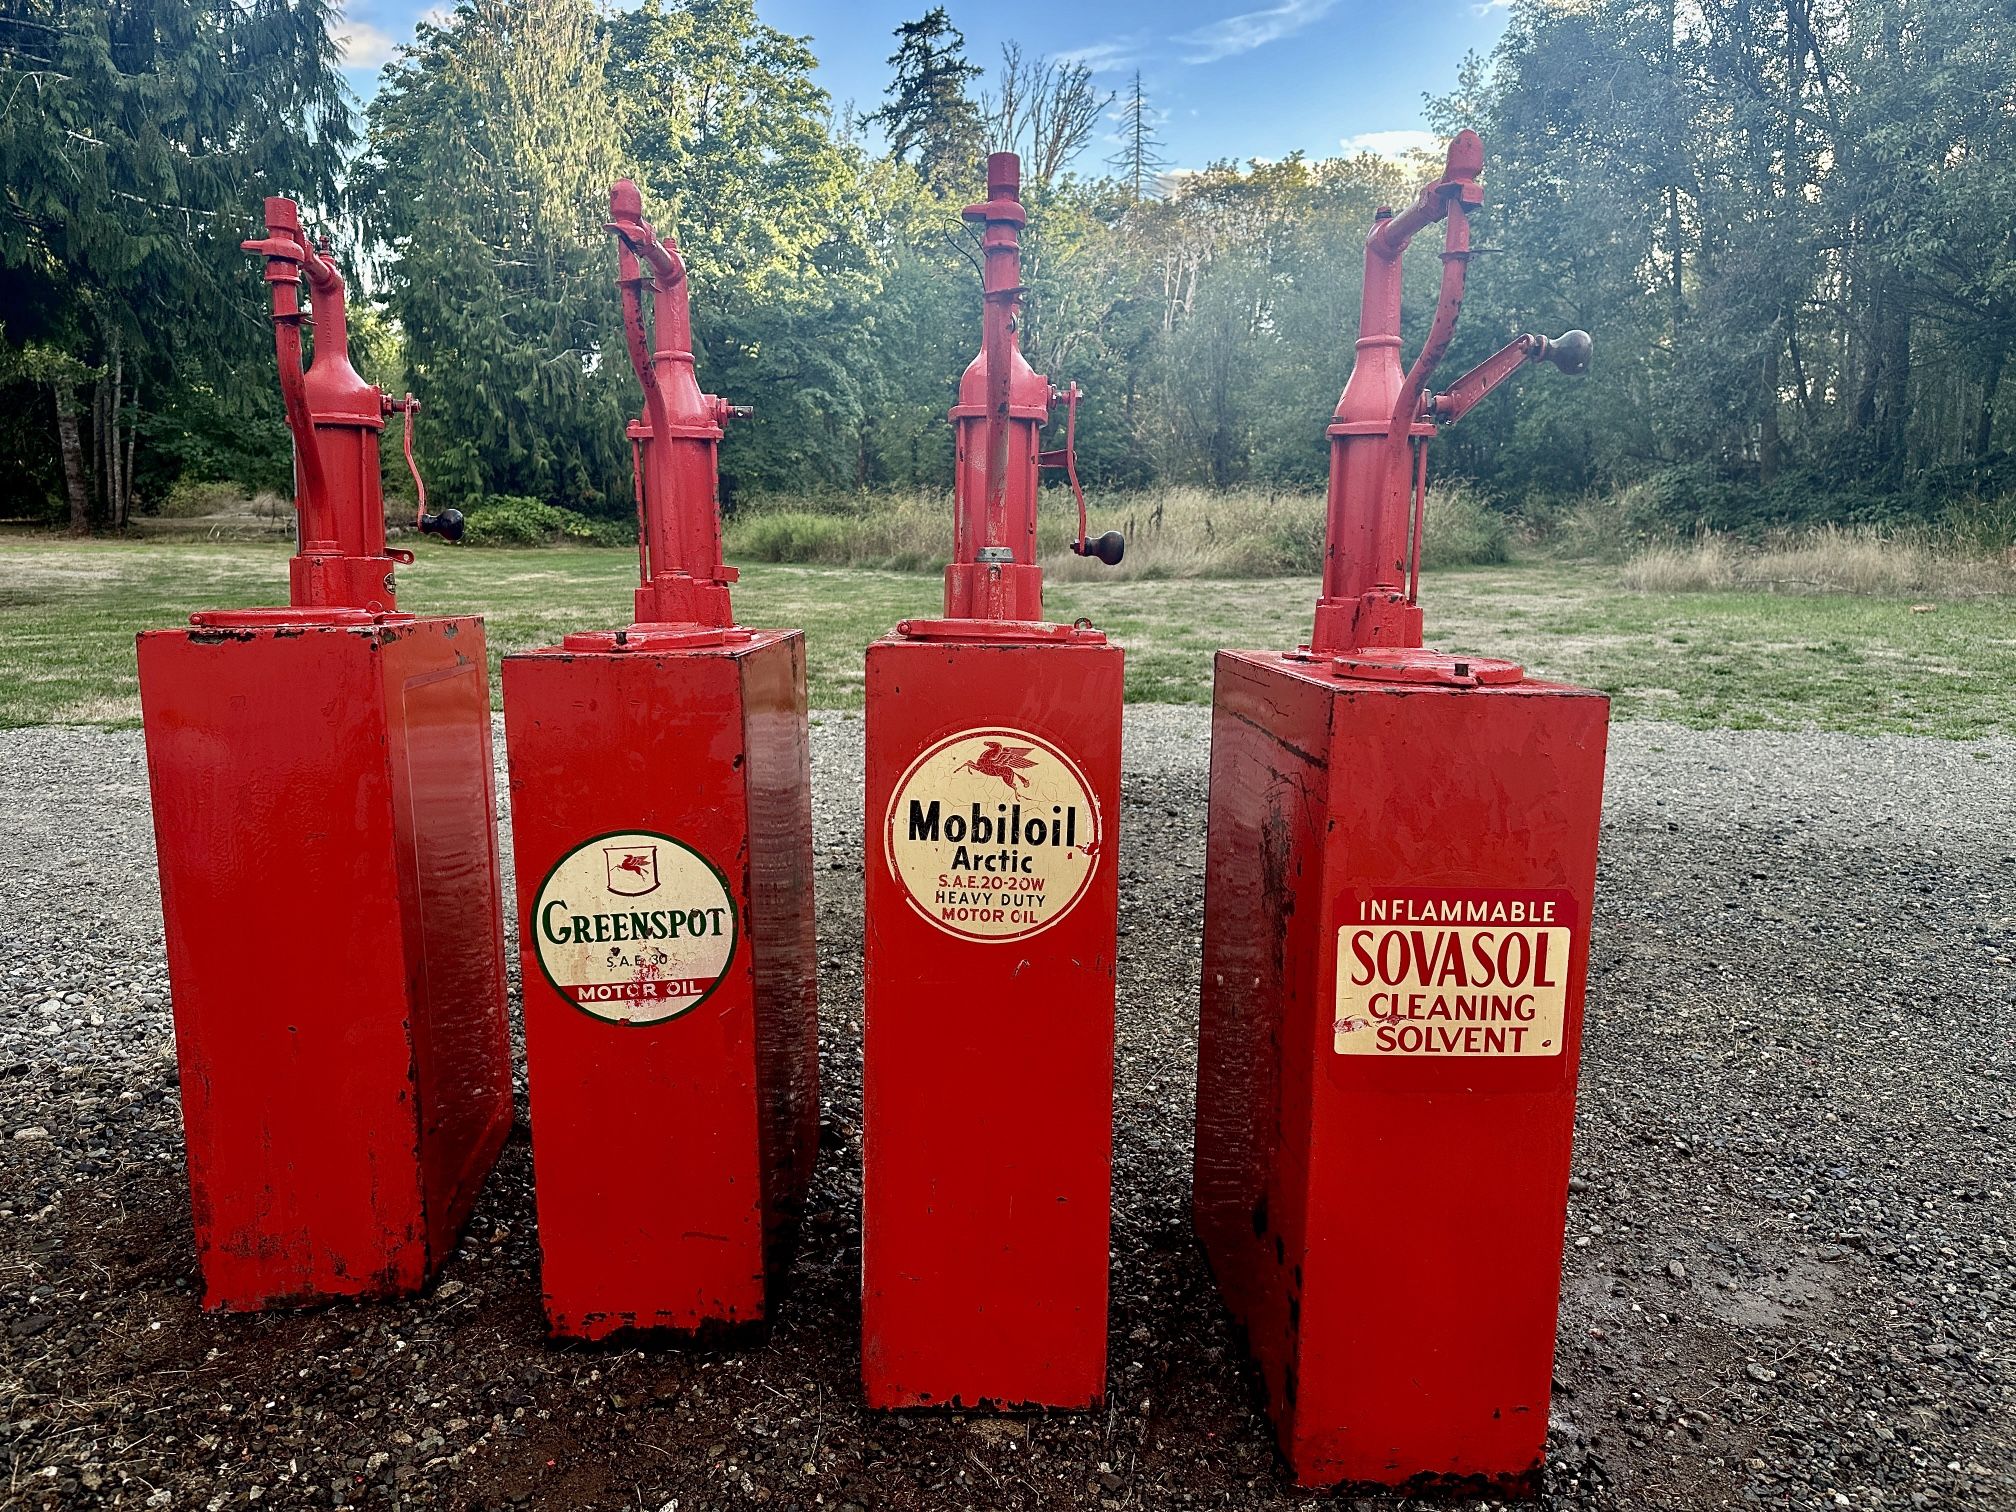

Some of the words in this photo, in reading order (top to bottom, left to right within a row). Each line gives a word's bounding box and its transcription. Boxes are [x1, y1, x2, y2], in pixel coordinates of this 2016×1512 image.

[908, 799, 1076, 847] Mobiloil
[951, 846, 1033, 874] Arctic
[935, 891, 993, 906] HEAVY
[1001, 893, 1046, 907] DUTY
[1360, 899, 1556, 922] INFLAMMABLE
[542, 899, 726, 944] GREENSPOT
[941, 907, 1004, 922] MOTOR
[1011, 910, 1038, 924] OIL
[651, 954, 668, 964] 30
[1351, 930, 1556, 988] SOVASOL
[578, 984, 658, 1001] MOTOR
[666, 980, 703, 996] OIL
[1368, 993, 1536, 1021] CLEANING
[1376, 1026, 1529, 1053] SOLVENT
